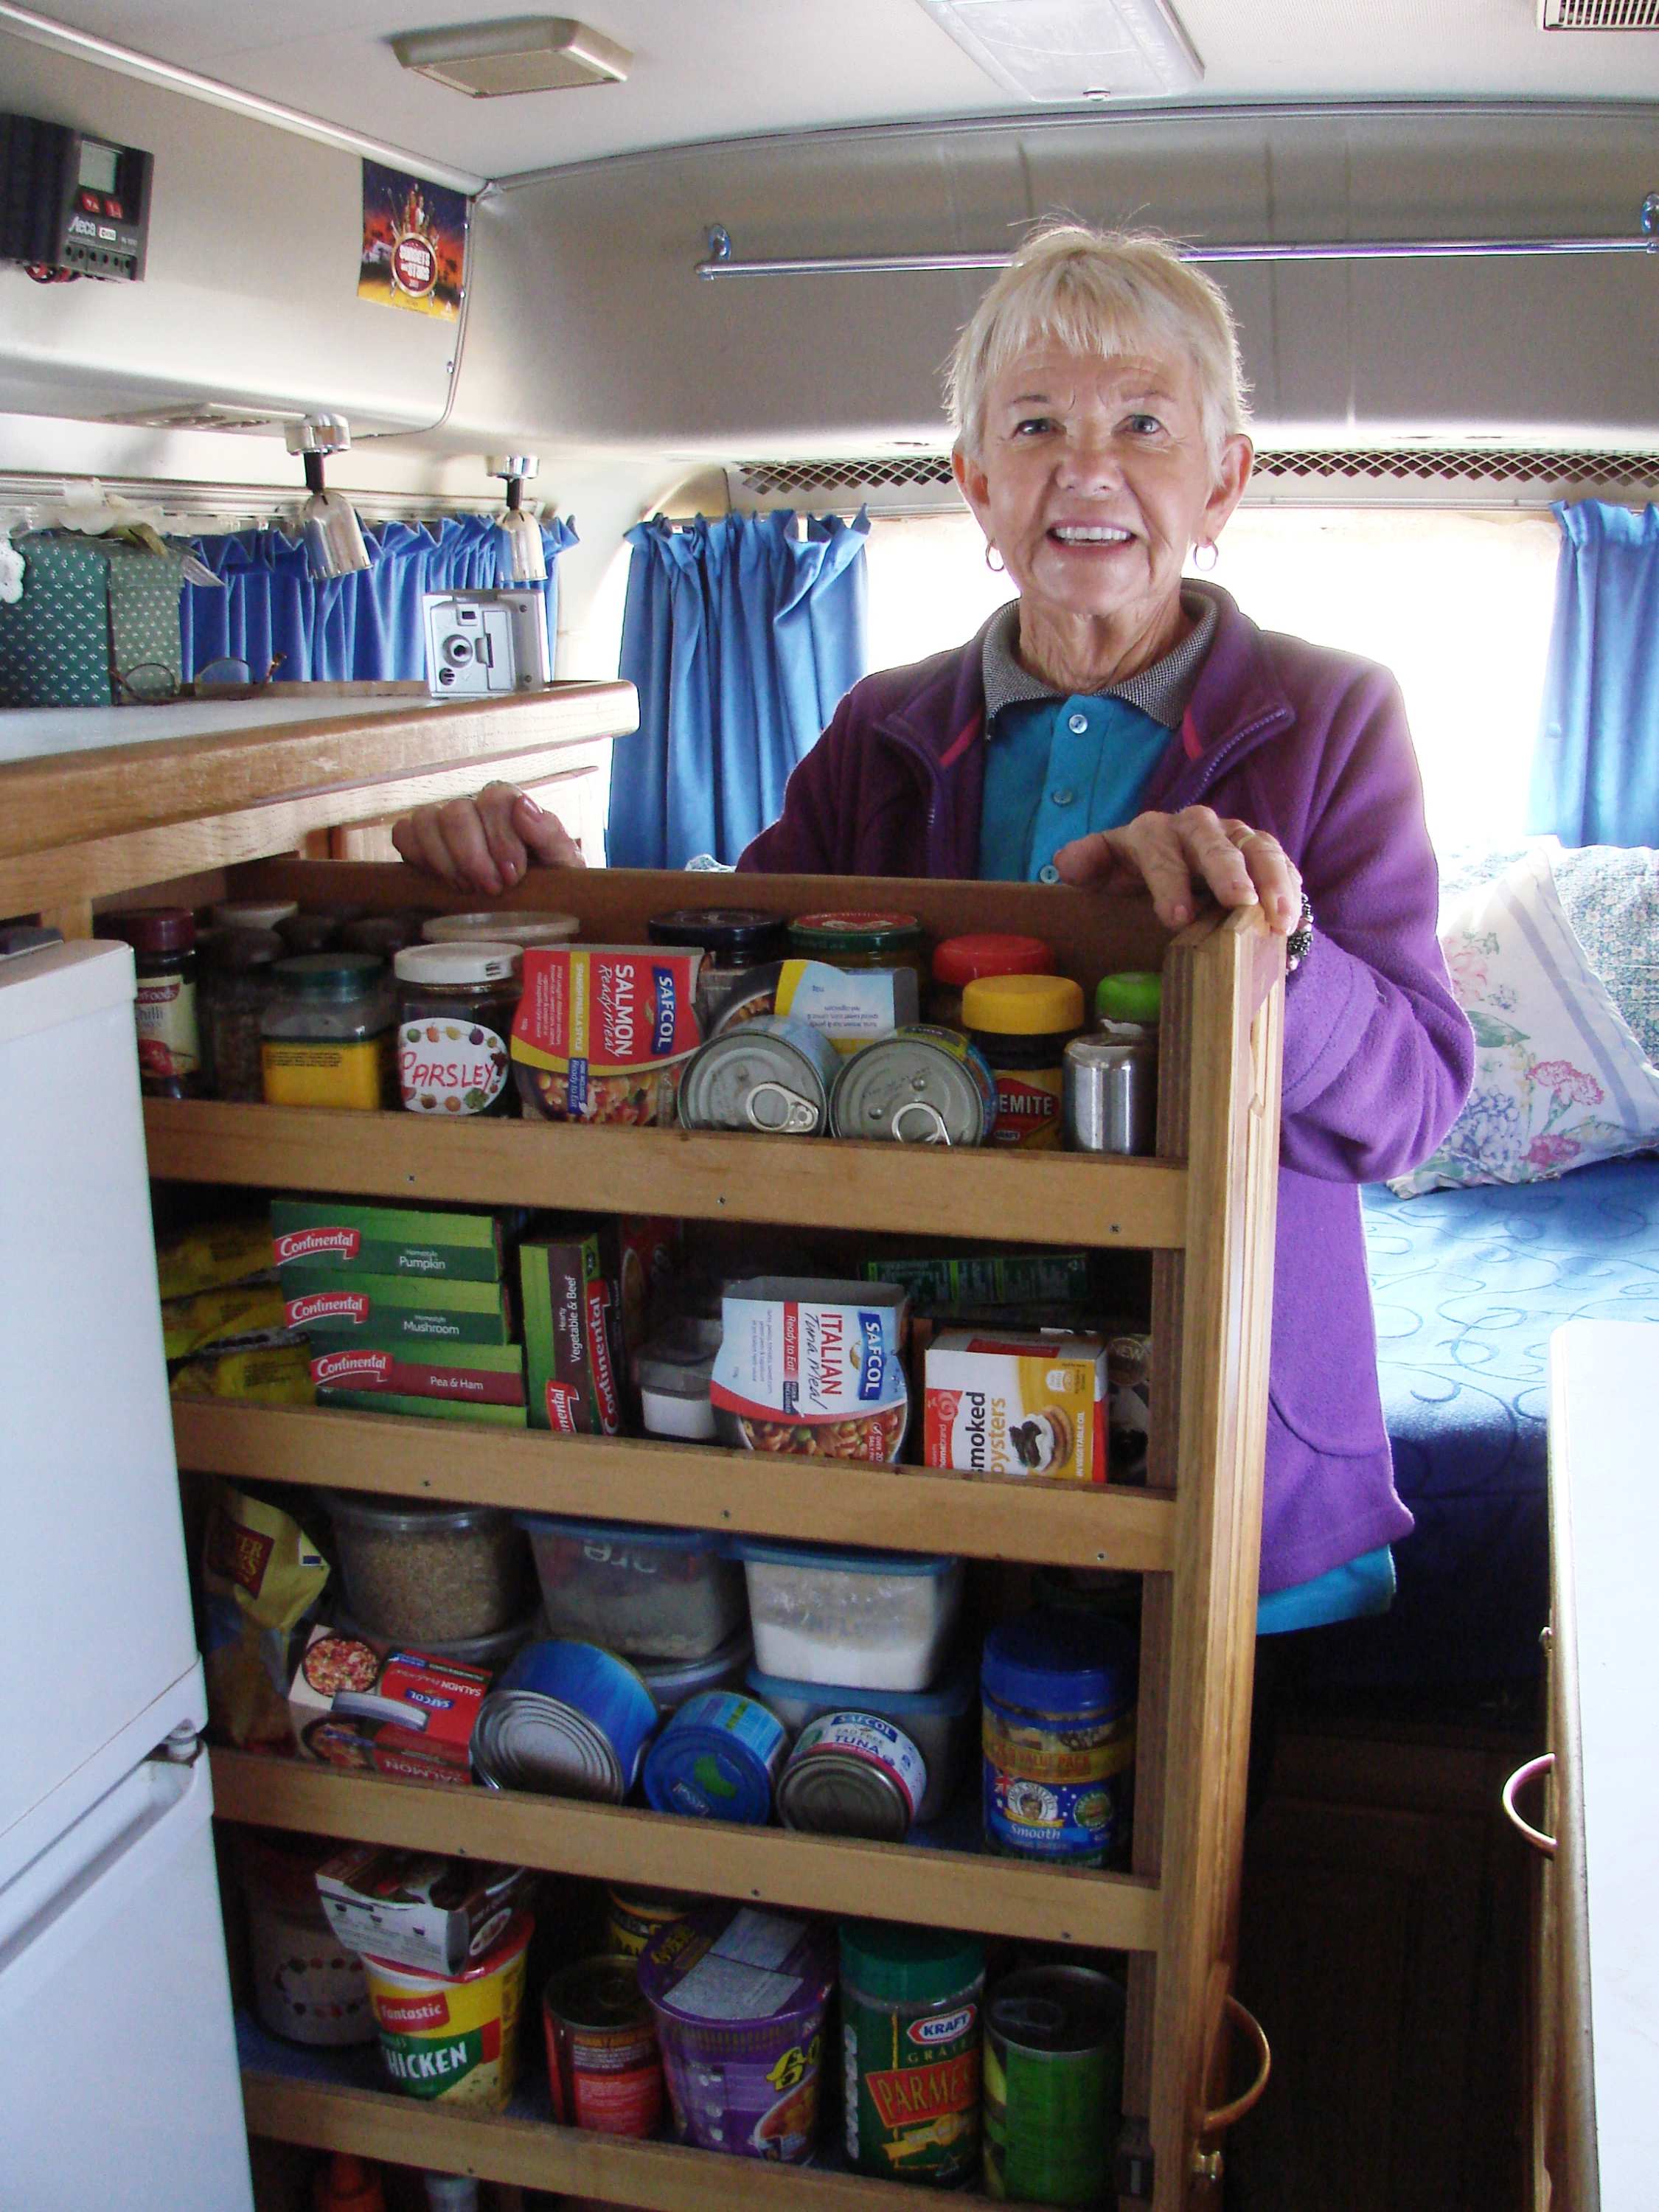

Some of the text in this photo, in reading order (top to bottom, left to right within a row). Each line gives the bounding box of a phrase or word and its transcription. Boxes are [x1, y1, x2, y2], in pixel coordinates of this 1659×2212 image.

[615, 964, 635, 1055] SALMON
[655, 975, 673, 1048] SAFCOL
[401, 1051, 495, 1093] PARSLEY
[570, 1060, 580, 1085] Ready
[571, 1085, 579, 1093] to
[998, 1093, 1053, 1116] EMITE
[279, 1231, 354, 1258] Continental
[400, 1256, 446, 1271] Pumpkin
[291, 1296, 364, 1321] Continental
[564, 1275, 583, 1363] Vegetable & Beef
[404, 1321, 459, 1335] Mushroom
[786, 1315, 797, 1371] Ready to Eat
[821, 1312, 843, 1396] ITALIAN
[316, 1355, 386, 1377] Continental
[589, 1297, 619, 1435] Continental
[804, 1312, 828, 1410] Tuna Meal
[866, 1321, 883, 1393] SAFCOL
[430, 1375, 484, 1391] Pea & Ham
[1076, 1411, 1085, 1423] OIL
[992, 1397, 1010, 1473] oysters
[1076, 1424, 1085, 1465] VEGETABLE
[409, 1691, 451, 1708] SAFCOL
[441, 1680, 482, 1697] SALMON
[838, 1714, 892, 1735] SAFCOL
[835, 1735, 879, 1755] TUNA
[1011, 1825, 1061, 1840] Smooth
[381, 2003, 443, 2020] fantastic
[923, 2014, 967, 2037] KRAFT
[384, 2040, 467, 2079] HICKEN
